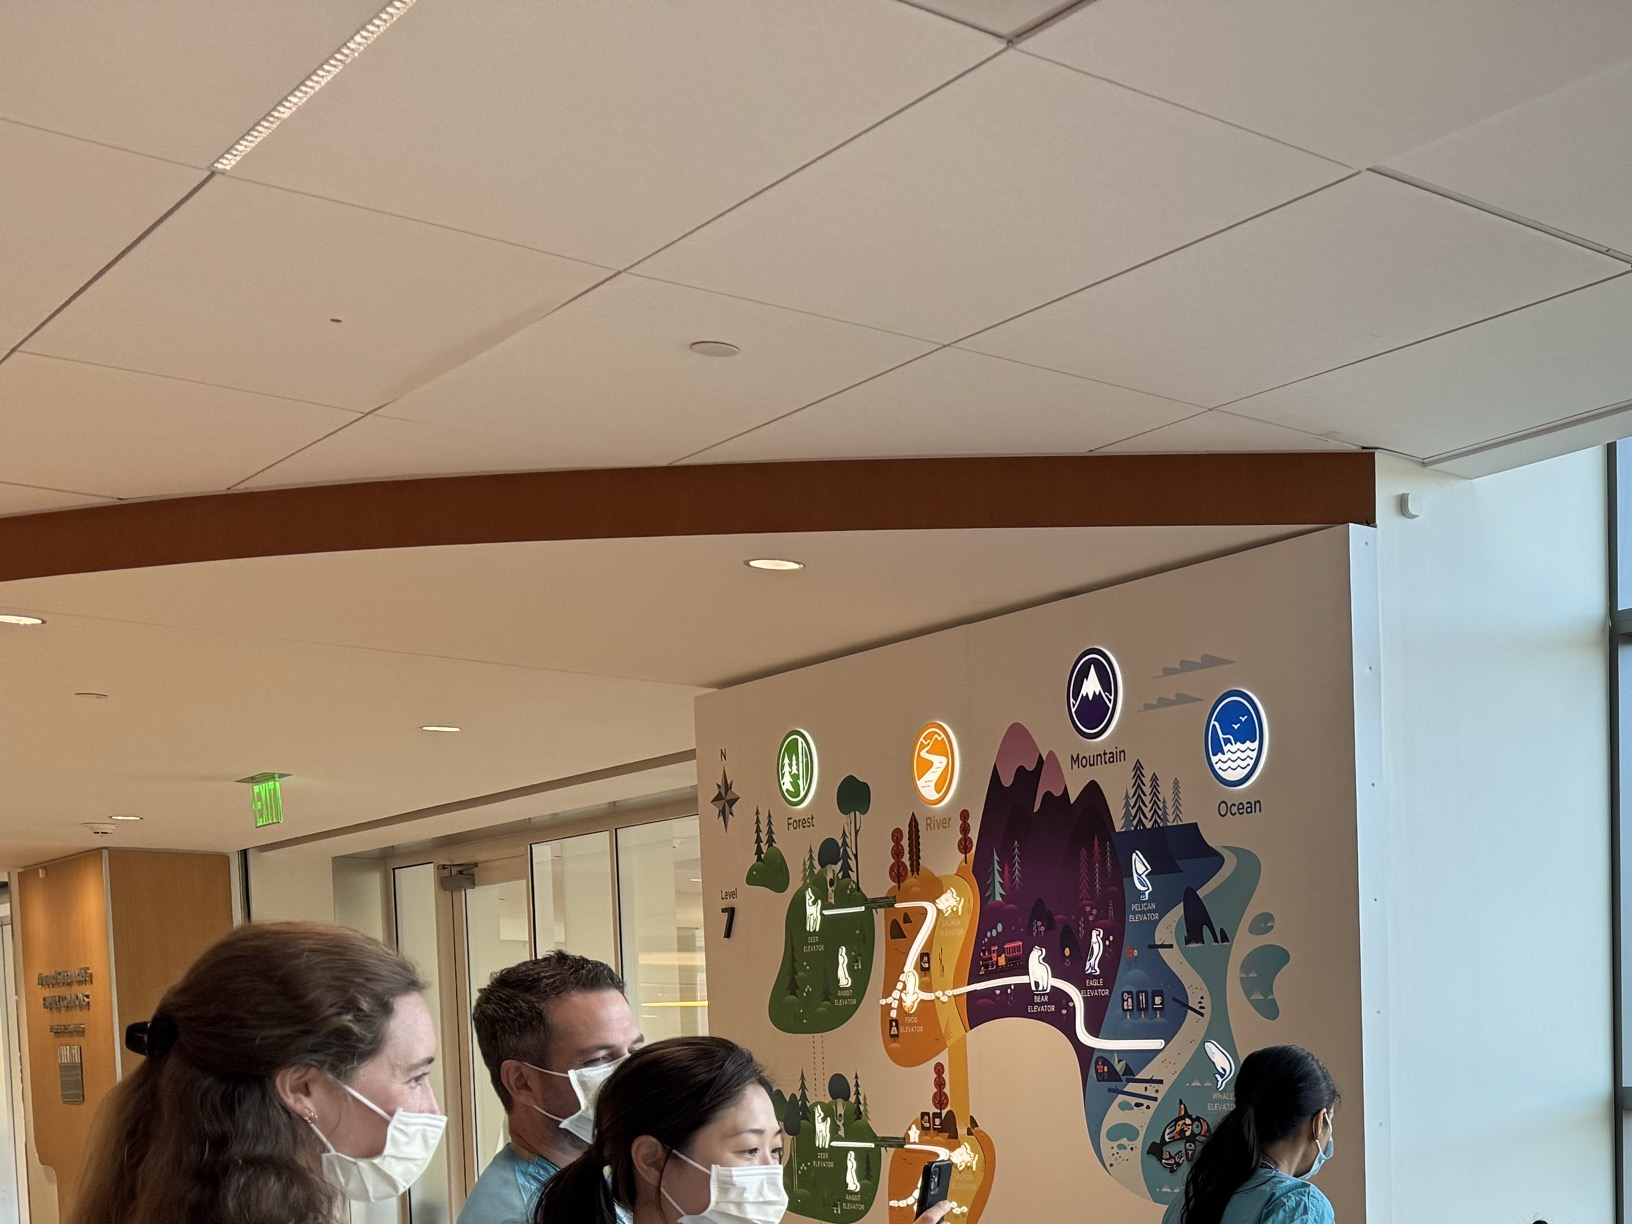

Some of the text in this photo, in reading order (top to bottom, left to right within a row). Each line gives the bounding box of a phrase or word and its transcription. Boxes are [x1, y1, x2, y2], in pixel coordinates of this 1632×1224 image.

[719, 748, 727, 762] N
[1070, 746, 1127, 770] Mountain
[1217, 799, 1262, 818] Ocean
[787, 814, 815, 832] Forest
[925, 815, 952, 832] River
[720, 887, 738, 901] Level
[1131, 902, 1156, 912] PELICAN
[720, 906, 736, 940] 7
[1128, 914, 1160, 923] ELEVATOR
[1085, 978, 1104, 987] EAGLE
[1033, 995, 1049, 1003] BEAR
[1080, 988, 1110, 997] ELEVATOR
[1027, 1005, 1056, 1013] ELEVATOR
